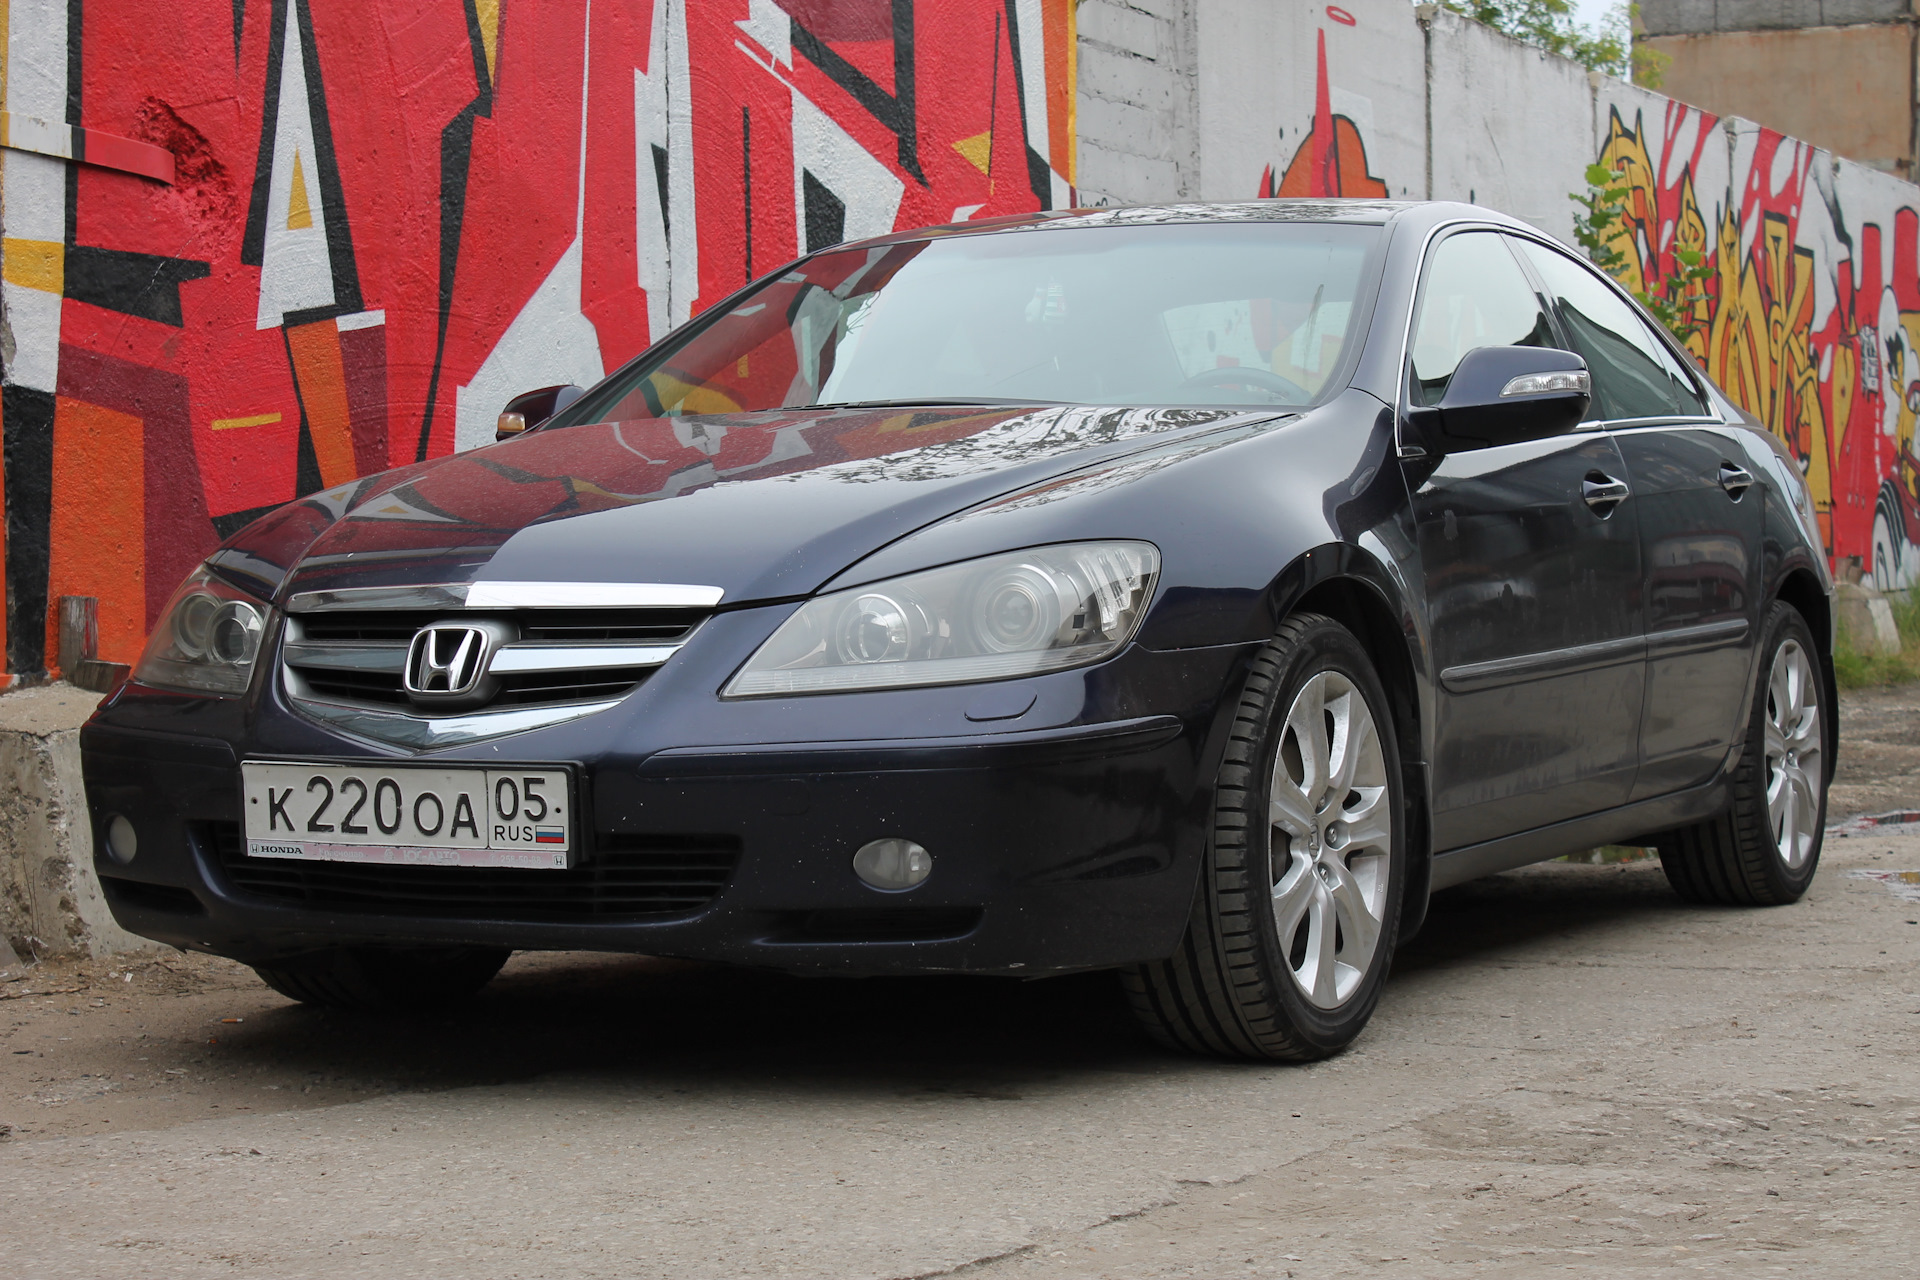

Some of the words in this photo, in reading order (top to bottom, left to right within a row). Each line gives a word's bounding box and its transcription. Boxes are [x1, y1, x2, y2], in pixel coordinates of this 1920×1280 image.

[495, 776, 548, 822] 05
[494, 825, 534, 842] RUS
[260, 845, 303, 855] HONDA
